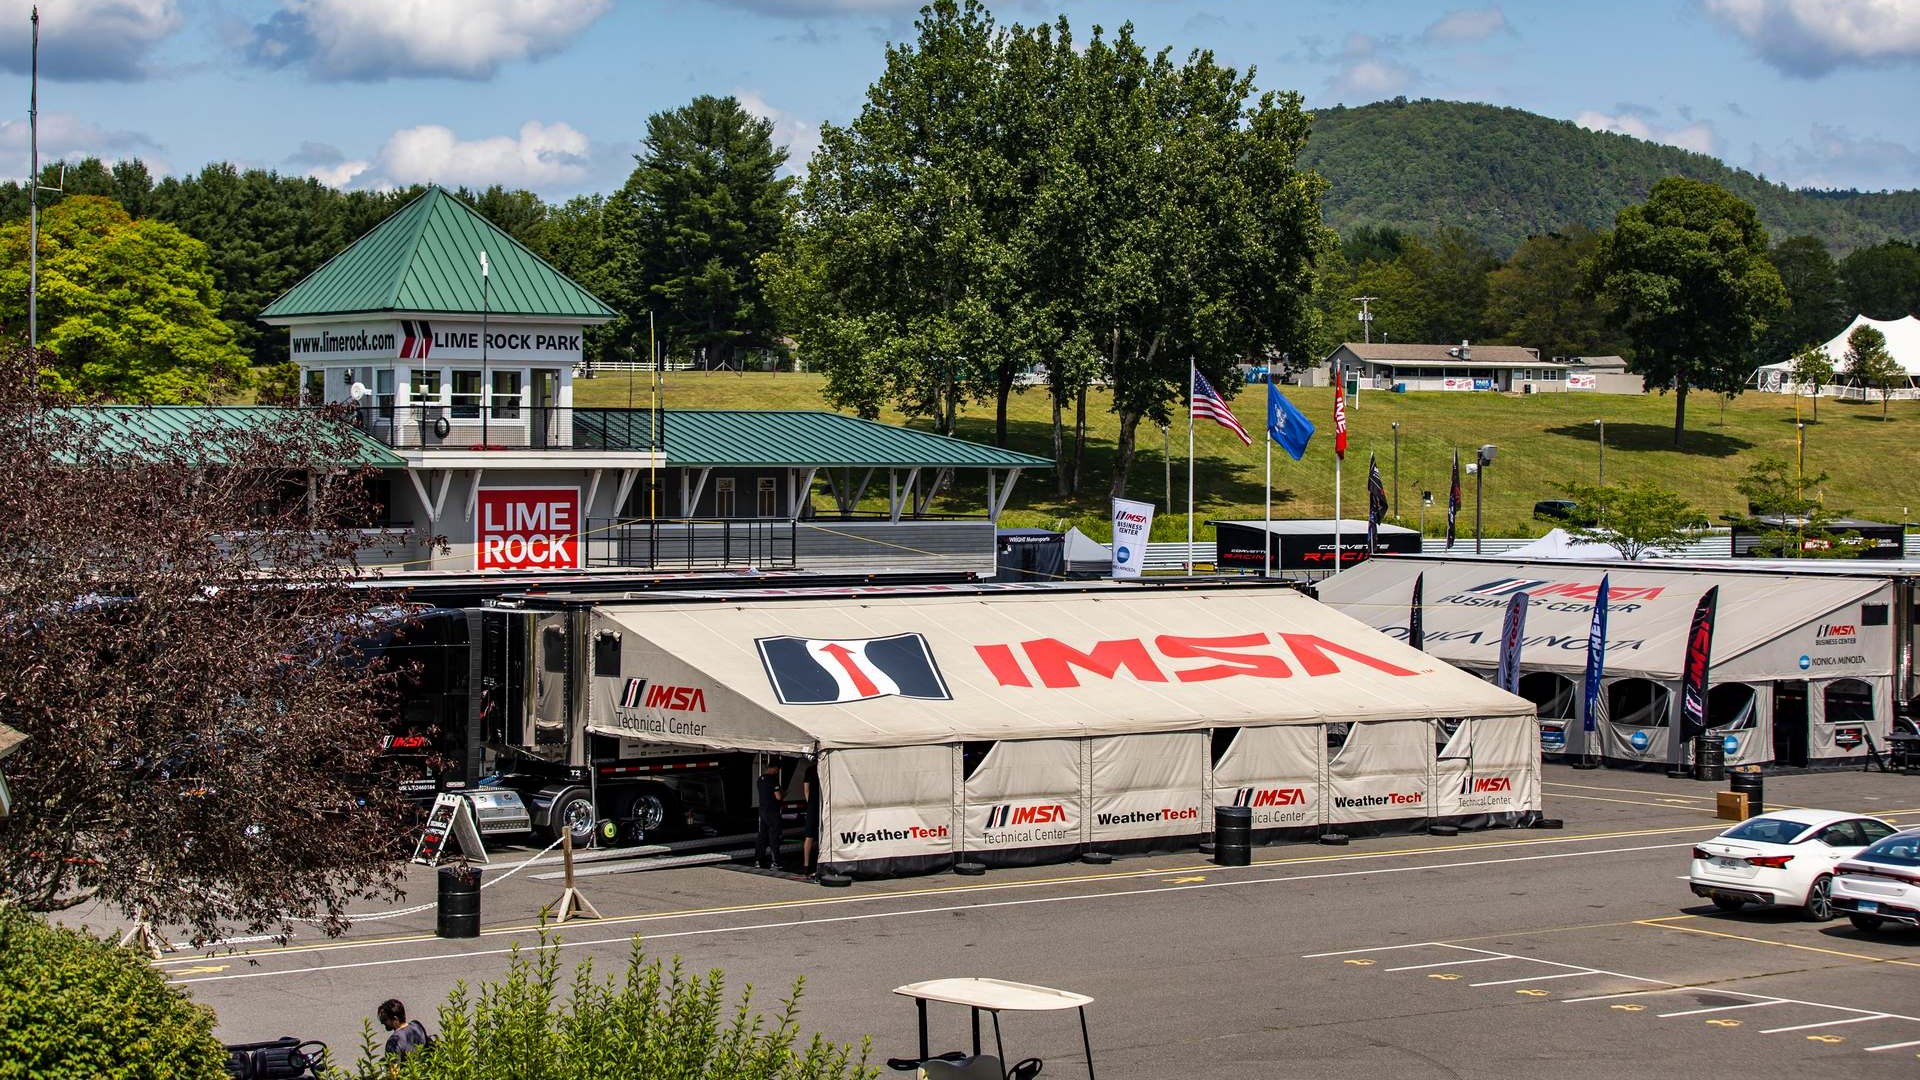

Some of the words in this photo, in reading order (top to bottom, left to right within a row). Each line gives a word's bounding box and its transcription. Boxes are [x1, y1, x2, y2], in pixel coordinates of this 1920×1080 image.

[293, 330, 395, 353] www.limerock.com
[434, 333, 478, 348] LIME
[486, 334, 531, 349] ROCK
[536, 335, 580, 350] PARK
[485, 502, 571, 531] LIME
[1125, 513, 1147, 524] IMSA
[1117, 521, 1143, 531] BUSINESS
[1119, 528, 1139, 536] CENTER
[484, 534, 571, 563] ROCK
[1527, 583, 1665, 601] IMSA
[1436, 595, 1548, 608] BUSINS
[1547, 602, 1642, 613] CENER
[1373, 624, 1484, 645] ONICA
[1829, 625, 1856, 636] IMSA
[1839, 637, 1857, 645] CENTER
[974, 632, 1421, 688] IMSA
[1812, 657, 1837, 666] KONICA
[1838, 655, 1866, 664] MINOLTA
[645, 685, 707, 712] IMSA
[616, 712, 666, 733] Technical
[669, 718, 707, 736] Center
[1474, 777, 1511, 793] IMSA
[1253, 788, 1306, 807] IMSA
[1335, 793, 1422, 808] WeatherTech
[1458, 797, 1486, 807] Technical
[1488, 795, 1511, 805] Center
[1012, 805, 1066, 825] IMSA
[1097, 807, 1198, 825] WeatherTech
[1250, 811, 1272, 824] nical
[1275, 810, 1305, 822] Center
[840, 825, 948, 845] WeatherTech
[982, 829, 1032, 844] Technical
[1035, 828, 1067, 841] Center
